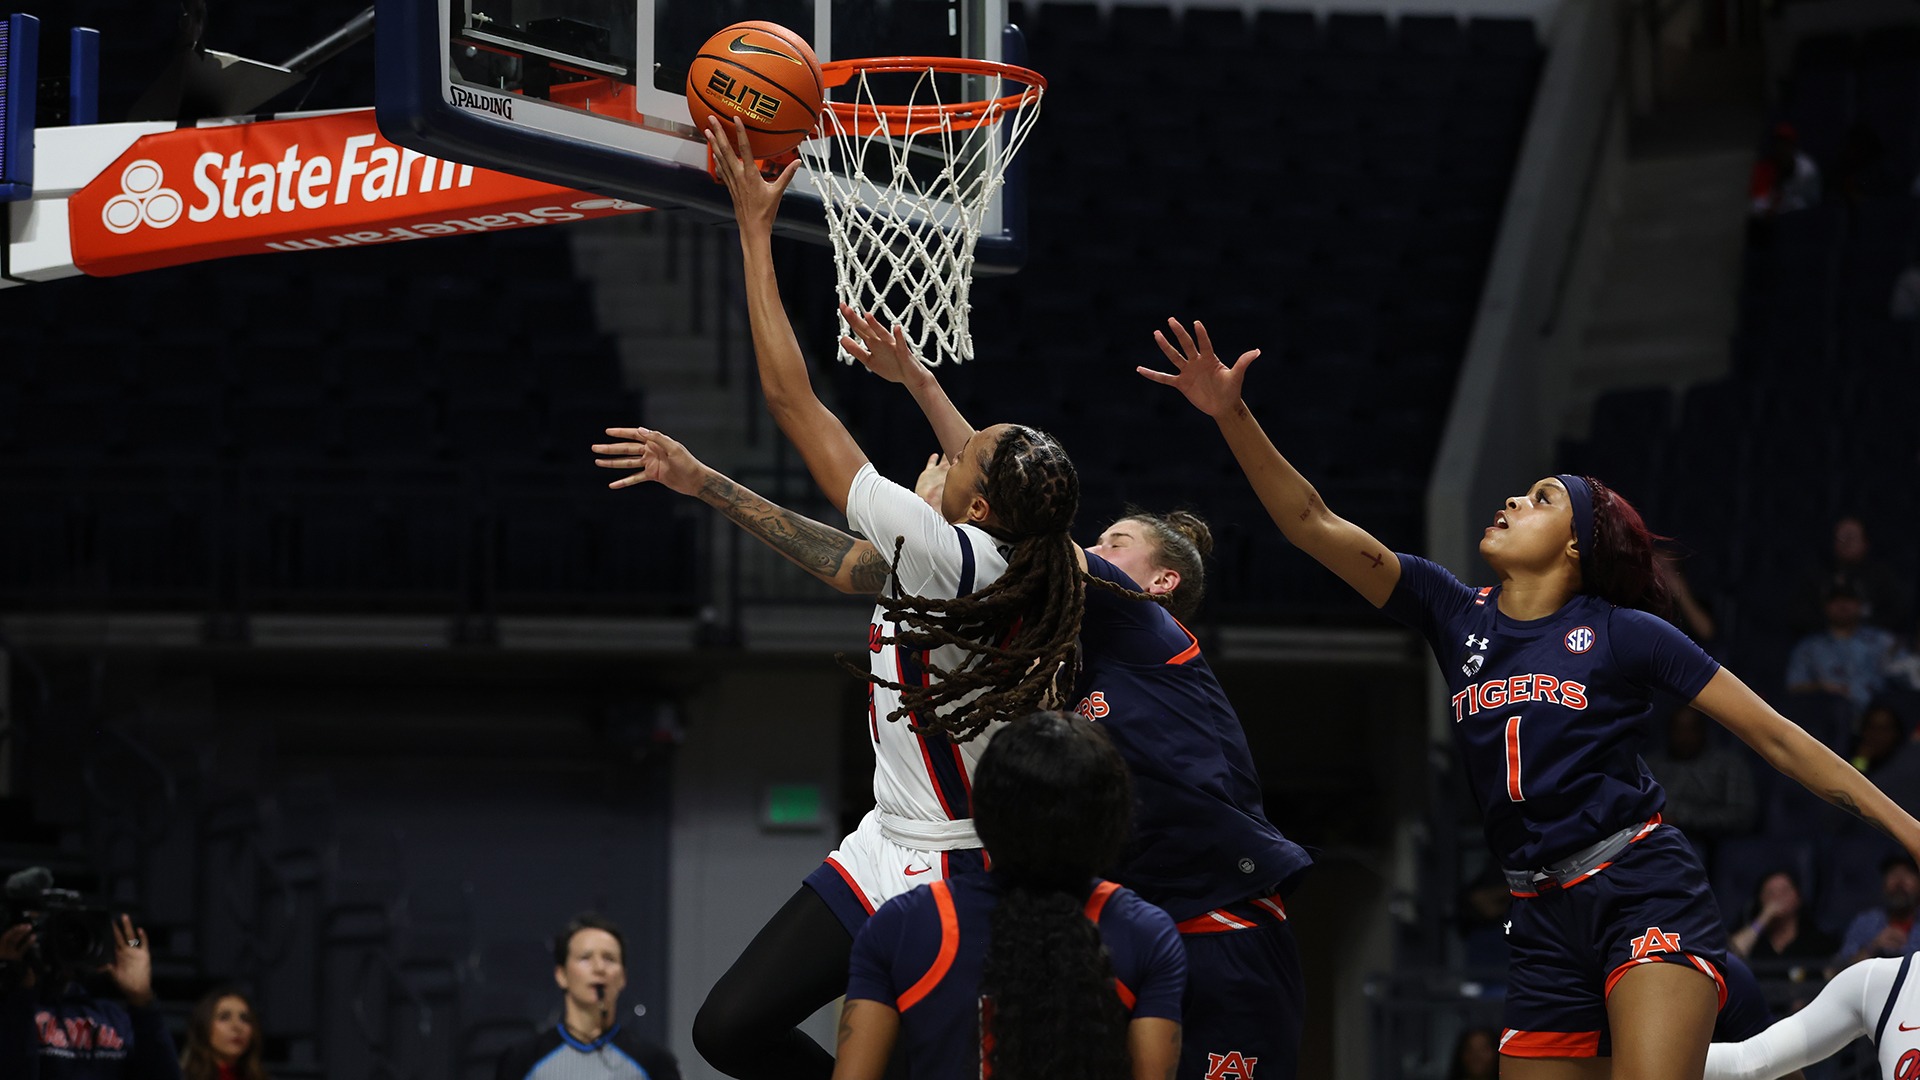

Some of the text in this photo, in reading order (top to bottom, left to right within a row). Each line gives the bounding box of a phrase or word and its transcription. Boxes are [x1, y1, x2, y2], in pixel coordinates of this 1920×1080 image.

[450, 85, 512, 120] SPALDING
[707, 68, 782, 119] ELITE
[1566, 628, 1593, 652] SEC
[1452, 673, 1589, 722] TIGERS
[1505, 716, 1525, 802] 1
